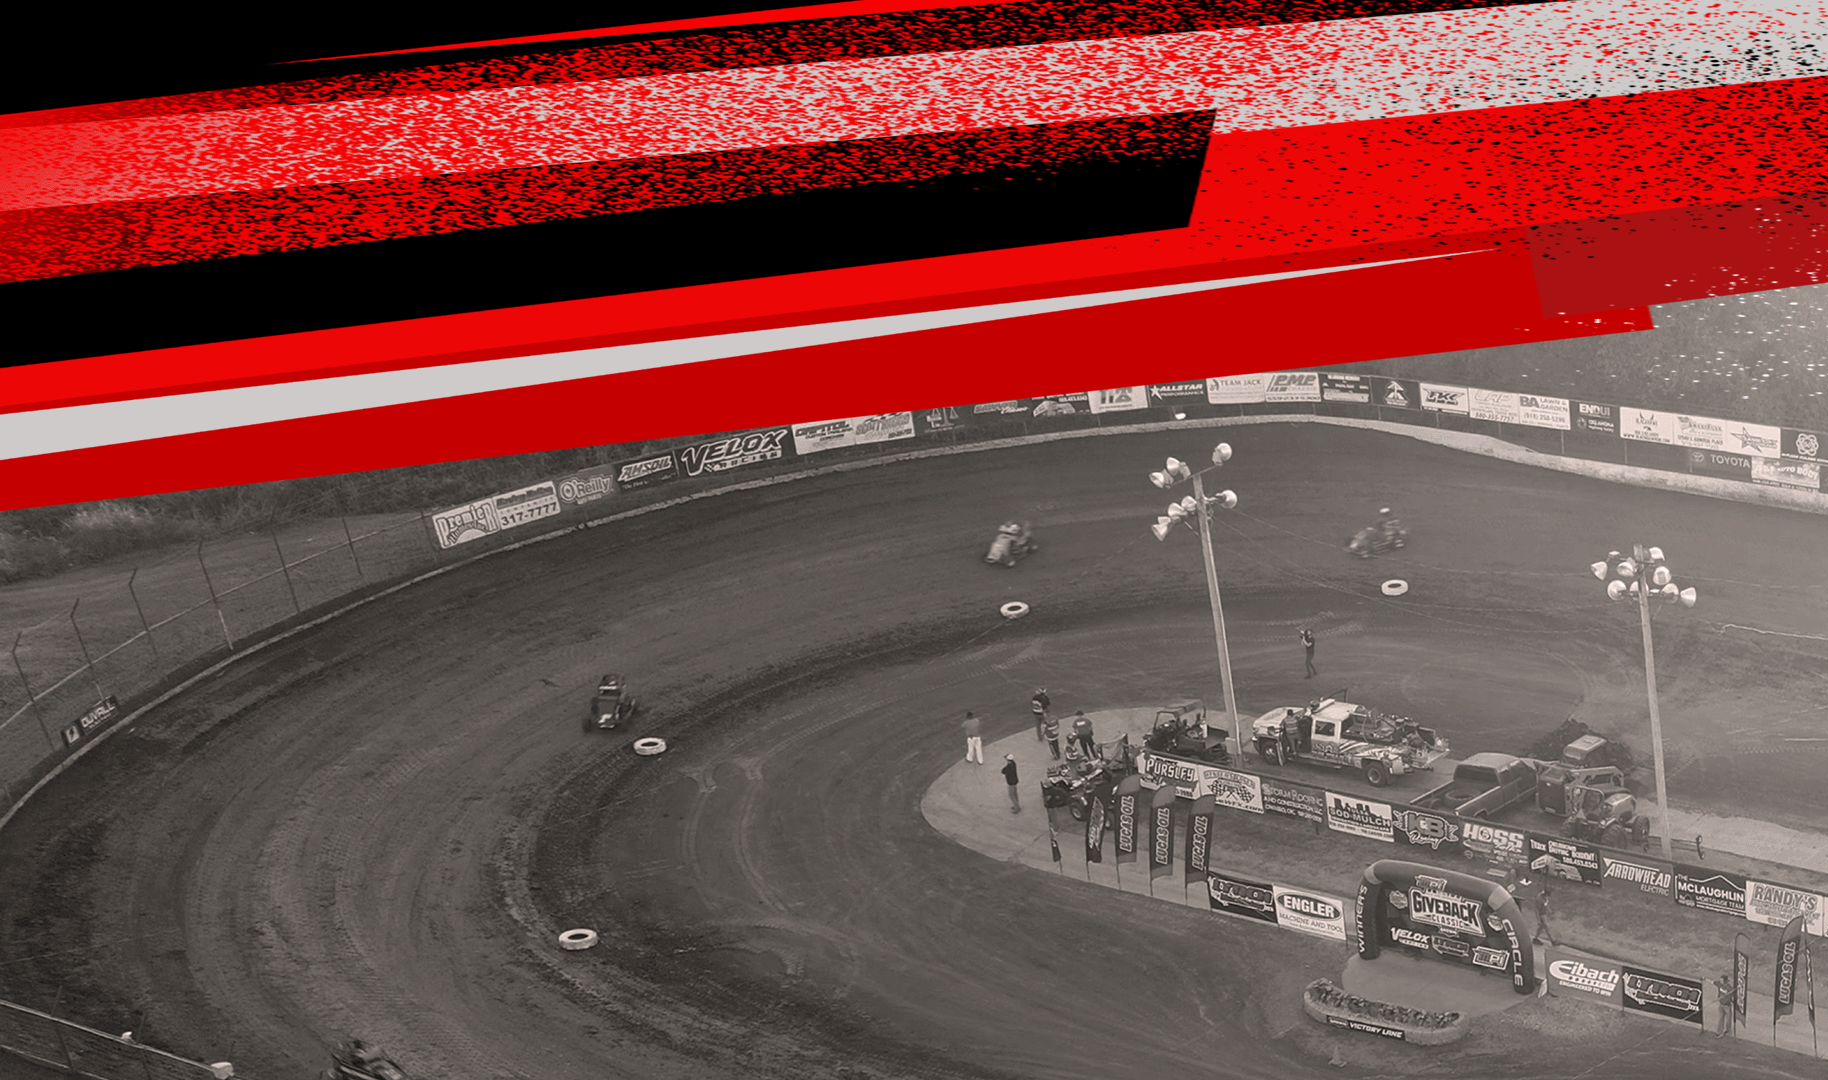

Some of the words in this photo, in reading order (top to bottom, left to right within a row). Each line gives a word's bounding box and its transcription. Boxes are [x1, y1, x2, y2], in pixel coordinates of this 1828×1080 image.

[1160, 383, 1204, 392] ALLSTAR
[1519, 395, 1540, 409] BA
[681, 429, 789, 477] VELOX
[1709, 453, 1751, 469] TOYOTA
[618, 454, 674, 482] AMSOIL
[501, 502, 559, 527] 317-7777
[1125, 795, 1135, 815] OIL
[1161, 807, 1171, 828] OIL
[1119, 812, 1134, 853] LUCAS
[1198, 815, 1209, 837] OIL
[1463, 822, 1525, 848] HOSS
[1154, 826, 1171, 865] LUCAS
[1191, 834, 1206, 871] LUCAS
[1603, 860, 1672, 889] ARROWHEAD
[1640, 883, 1670, 897] ELECTRIC
[1677, 881, 1745, 903] MCLAUGHLIN
[1283, 894, 1336, 919] ENGLER
[1356, 884, 1368, 954] WINNERS
[1411, 890, 1482, 927] GIVEBACK
[1279, 911, 1310, 927] MACHINE
[1310, 919, 1326, 930] AND
[1326, 922, 1344, 934] TOOL
[1430, 913, 1465, 928] CLASSIC
[1390, 926, 1431, 944] VELOX
[1501, 917, 1523, 987] CIRCLE
[1784, 941, 1796, 963] OIL
[1549, 959, 1620, 989] Eibach
[1778, 961, 1794, 1005] LUCAS
[1348, 1021, 1382, 1035] VICTORY
[1381, 1028, 1403, 1039] LANE
